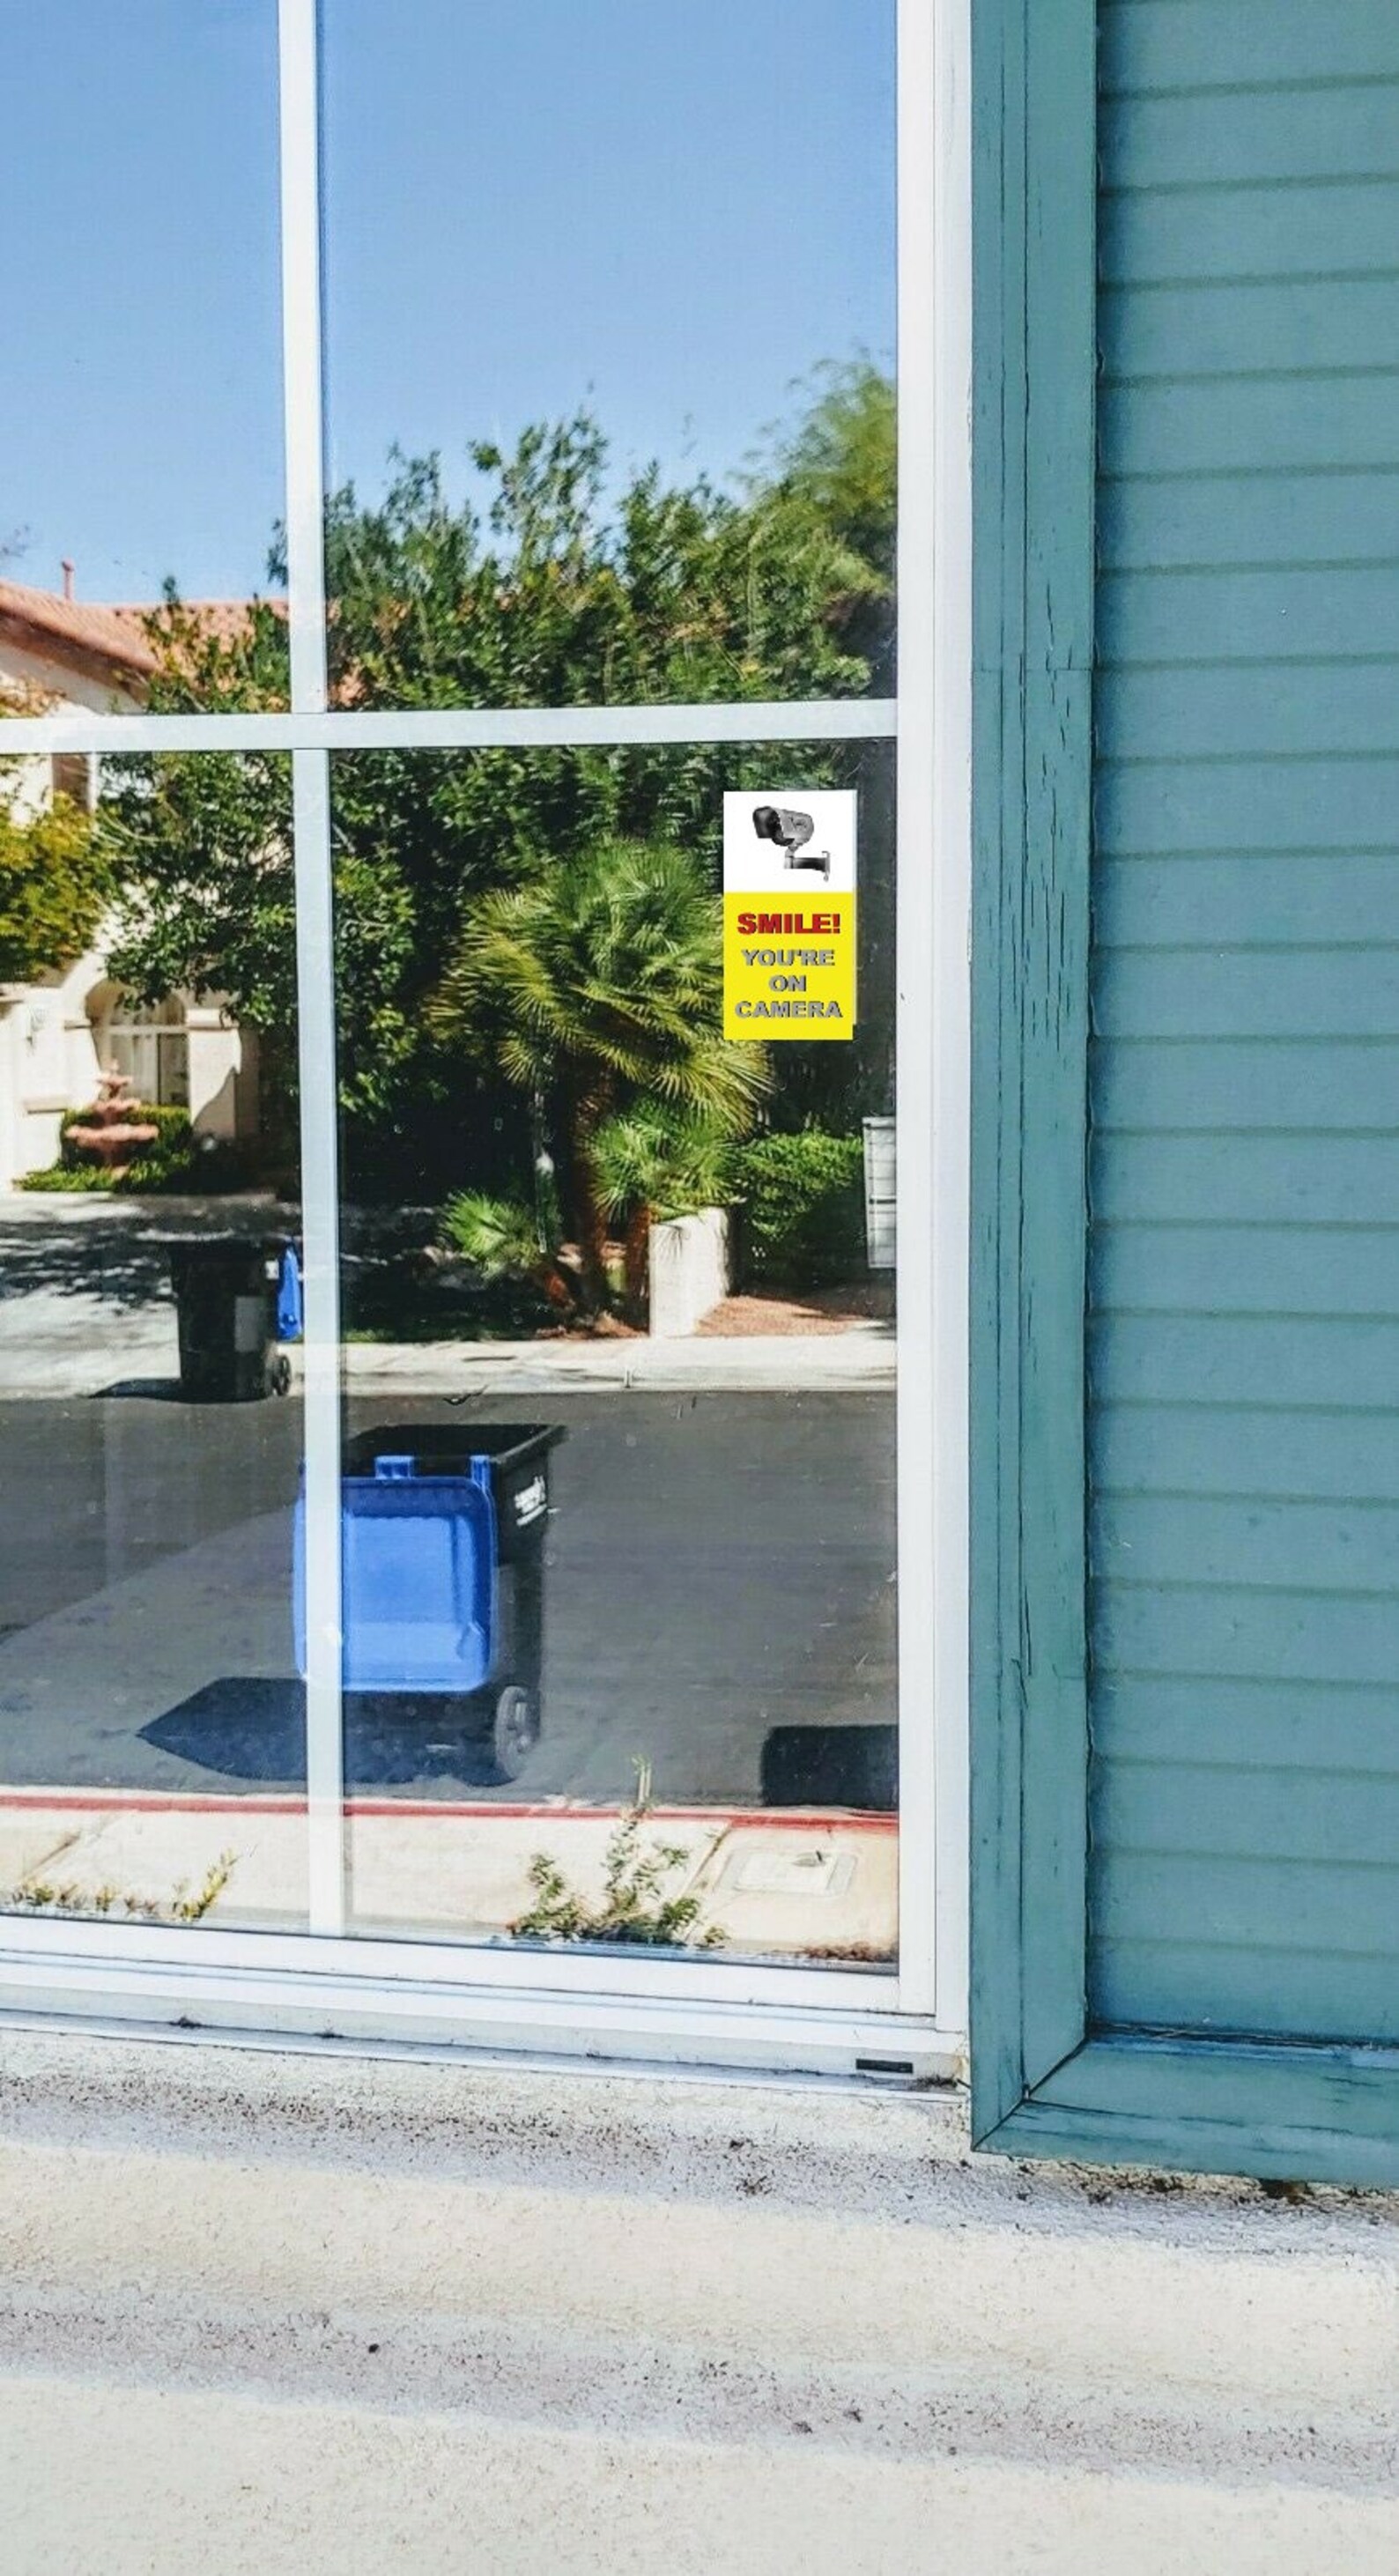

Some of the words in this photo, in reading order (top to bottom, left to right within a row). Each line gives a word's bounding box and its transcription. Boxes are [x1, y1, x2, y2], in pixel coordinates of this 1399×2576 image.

[737, 913, 840, 935] SMILE!
[741, 949, 835, 966] YOU'RE
[768, 974, 807, 992] ON
[735, 1001, 843, 1018] CAMERA
